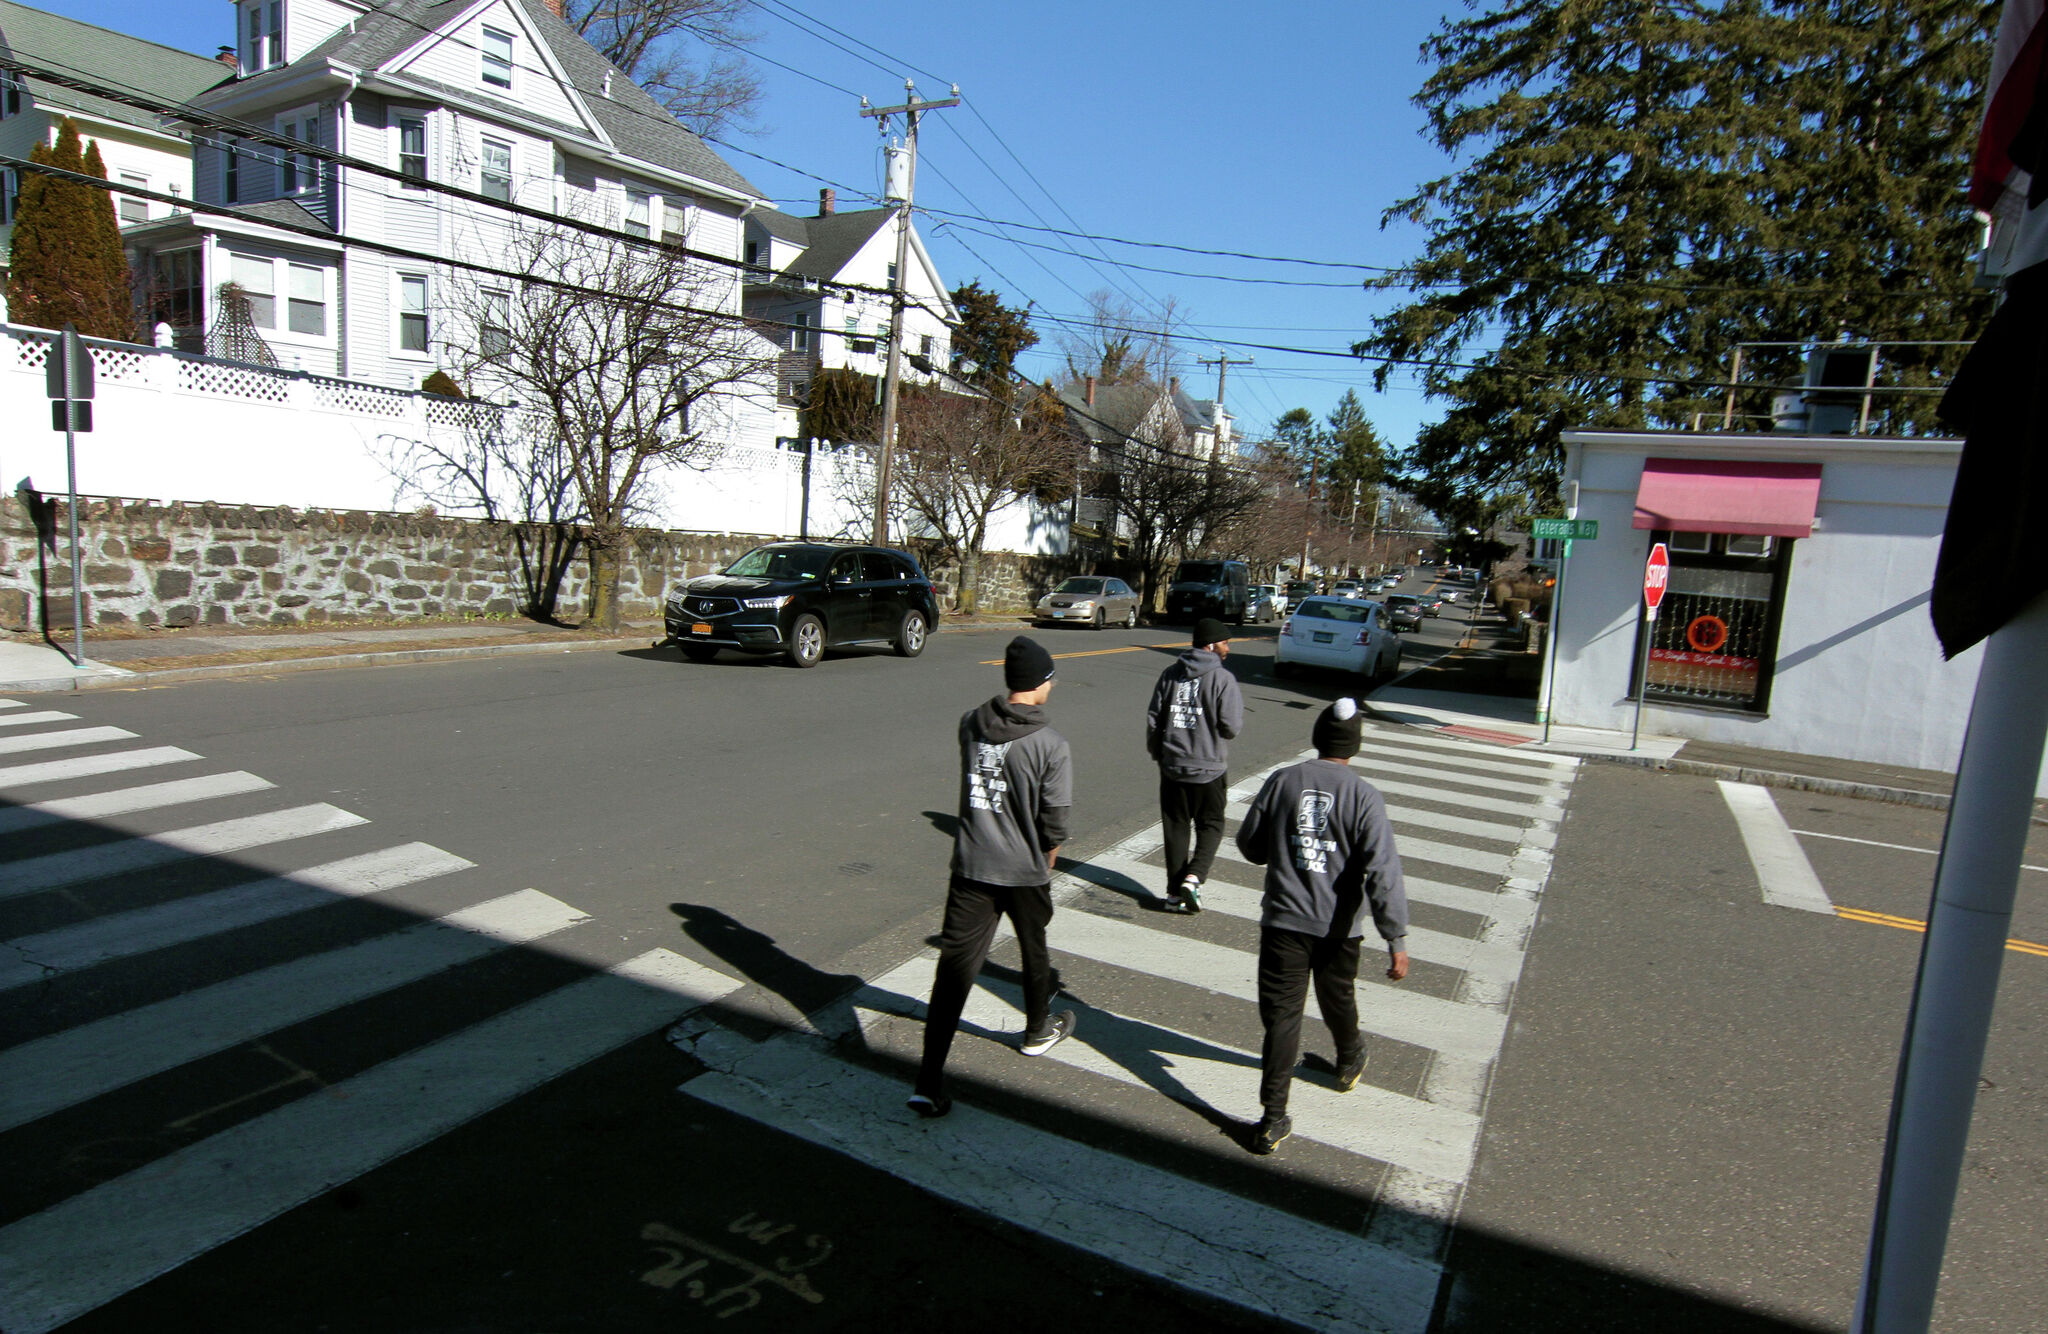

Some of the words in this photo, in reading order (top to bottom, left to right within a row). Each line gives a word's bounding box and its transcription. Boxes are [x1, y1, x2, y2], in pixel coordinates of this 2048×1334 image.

[1534, 519, 1574, 535] Veterans
[1646, 564, 1667, 588] STOP
[1317, 851, 1327, 862] A
